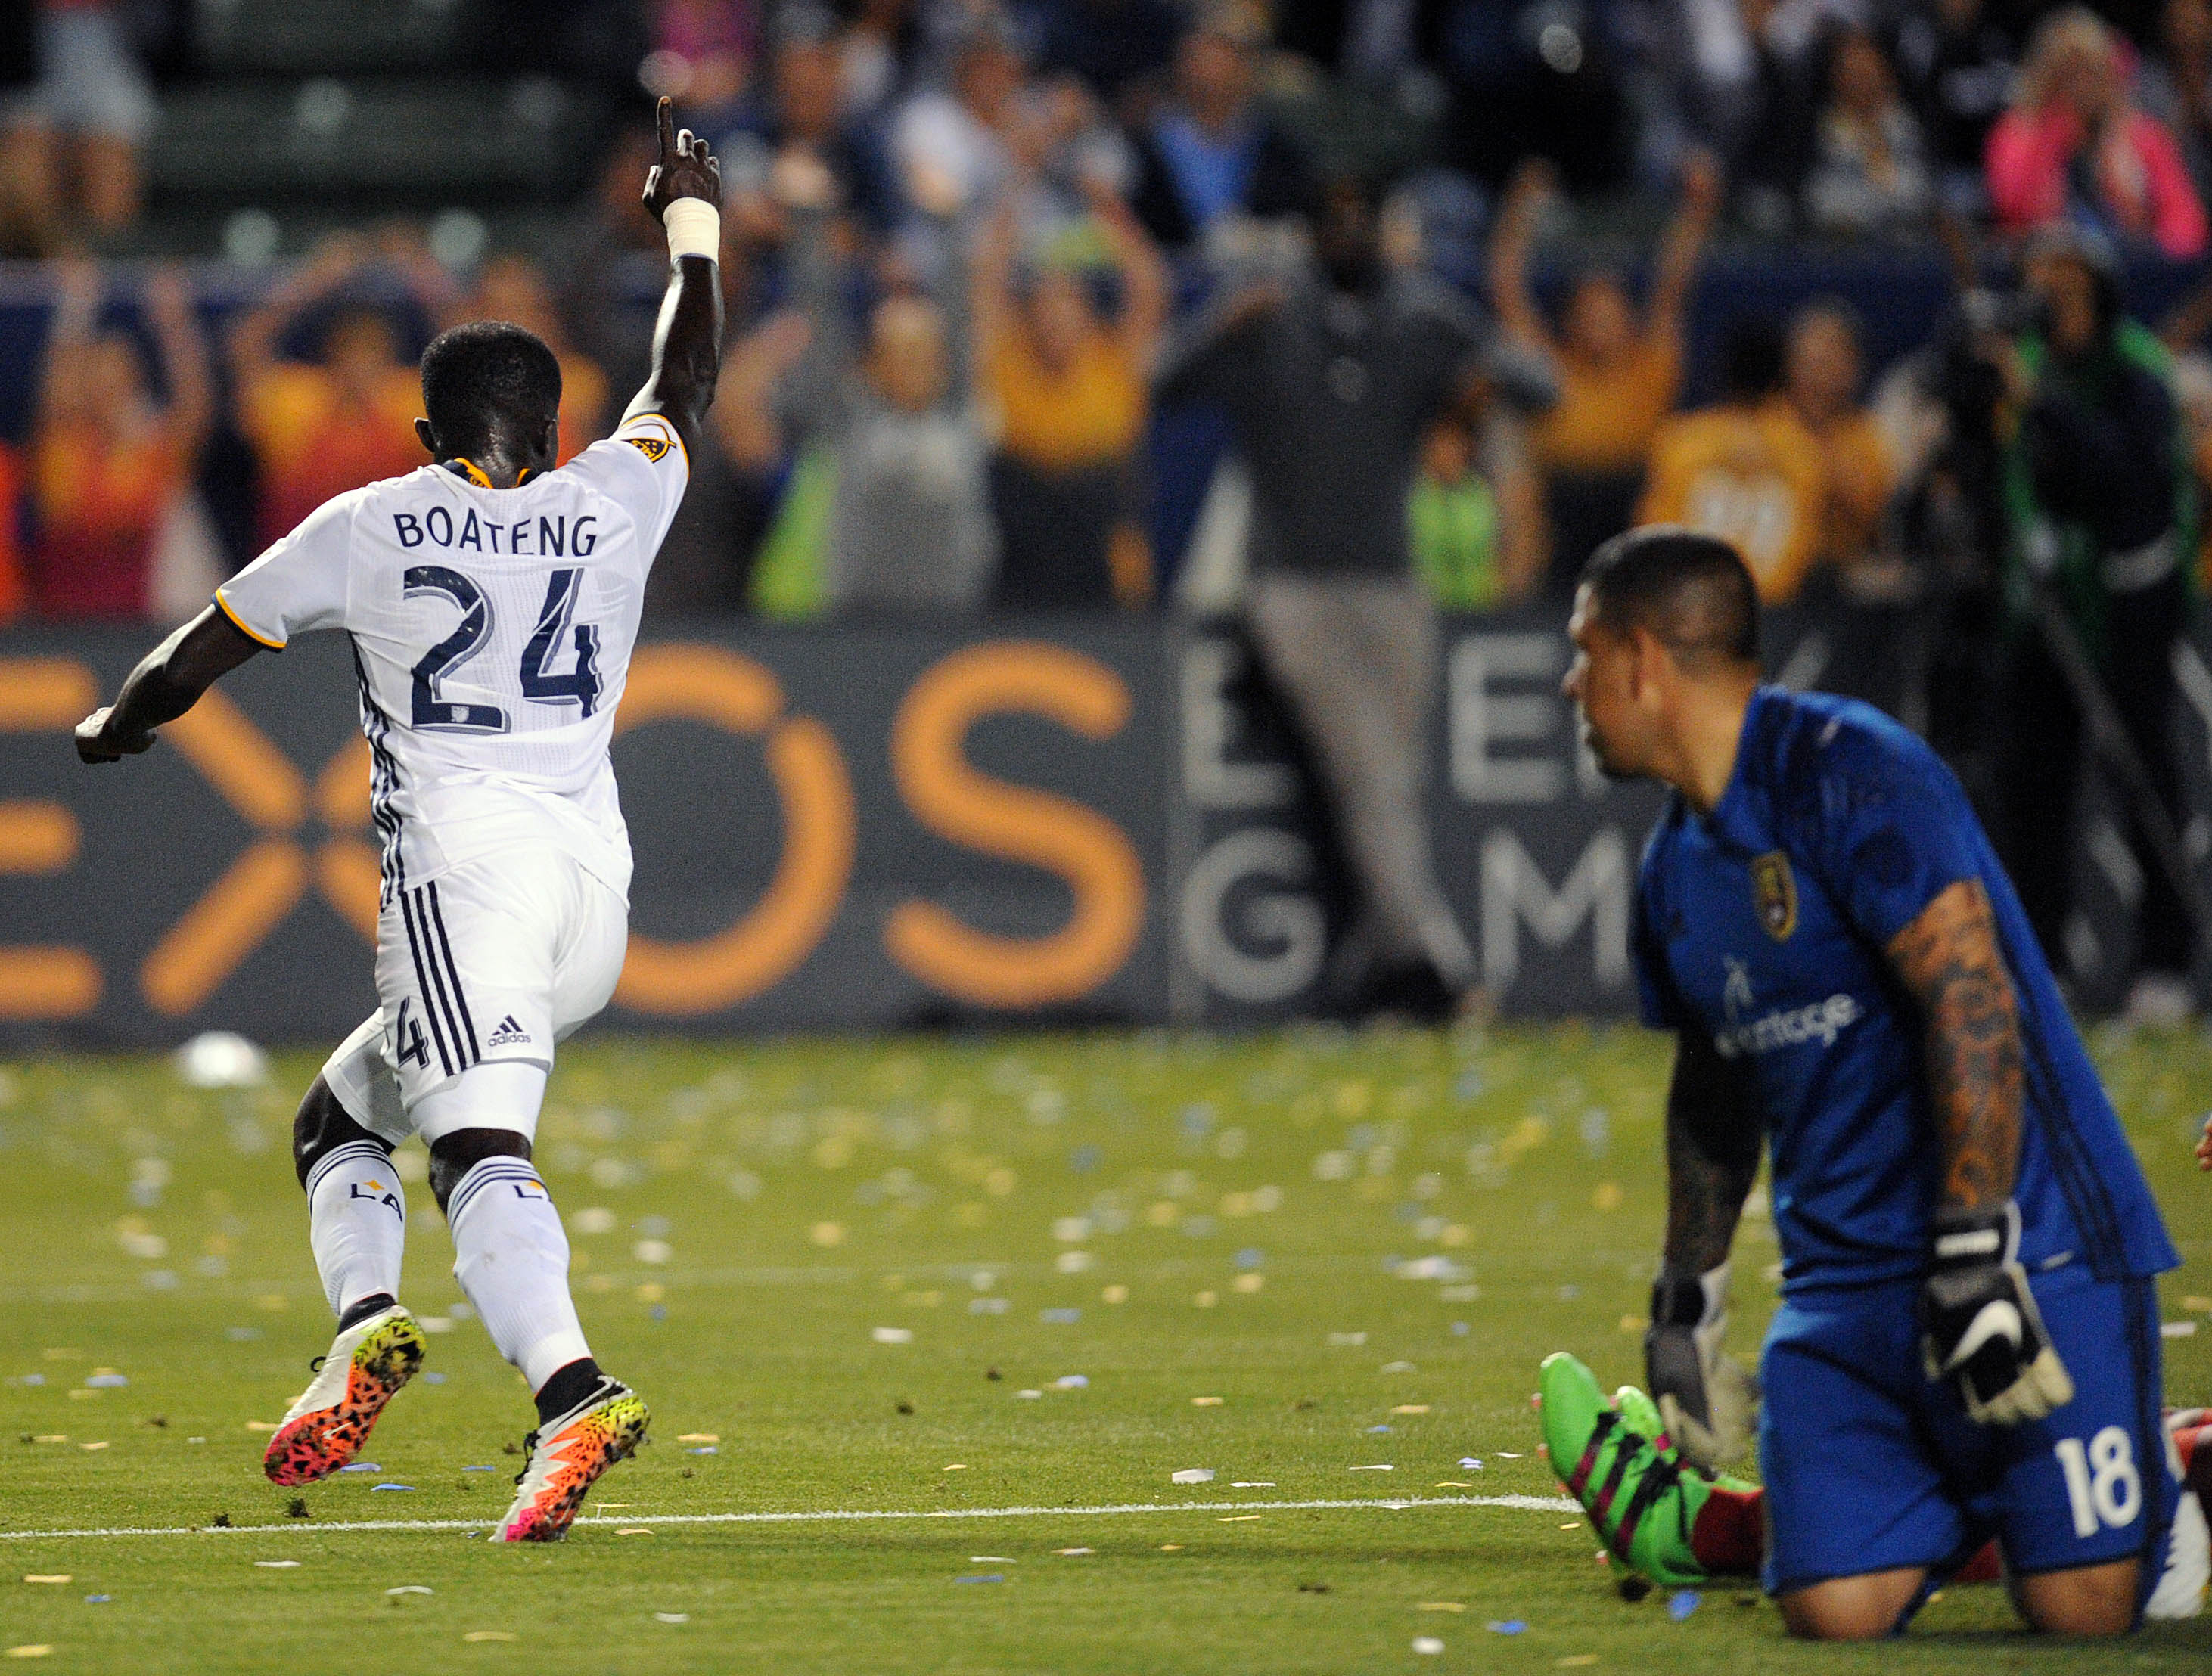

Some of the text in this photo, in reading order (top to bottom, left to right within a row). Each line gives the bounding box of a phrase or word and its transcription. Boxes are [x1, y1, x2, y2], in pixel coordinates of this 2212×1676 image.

[393, 505, 598, 557] BOATENG
[402, 564, 604, 736] 24
[487, 1029, 532, 1048] adidas
[350, 1183, 402, 1222] LA
[2055, 1426, 2142, 1538] 18
